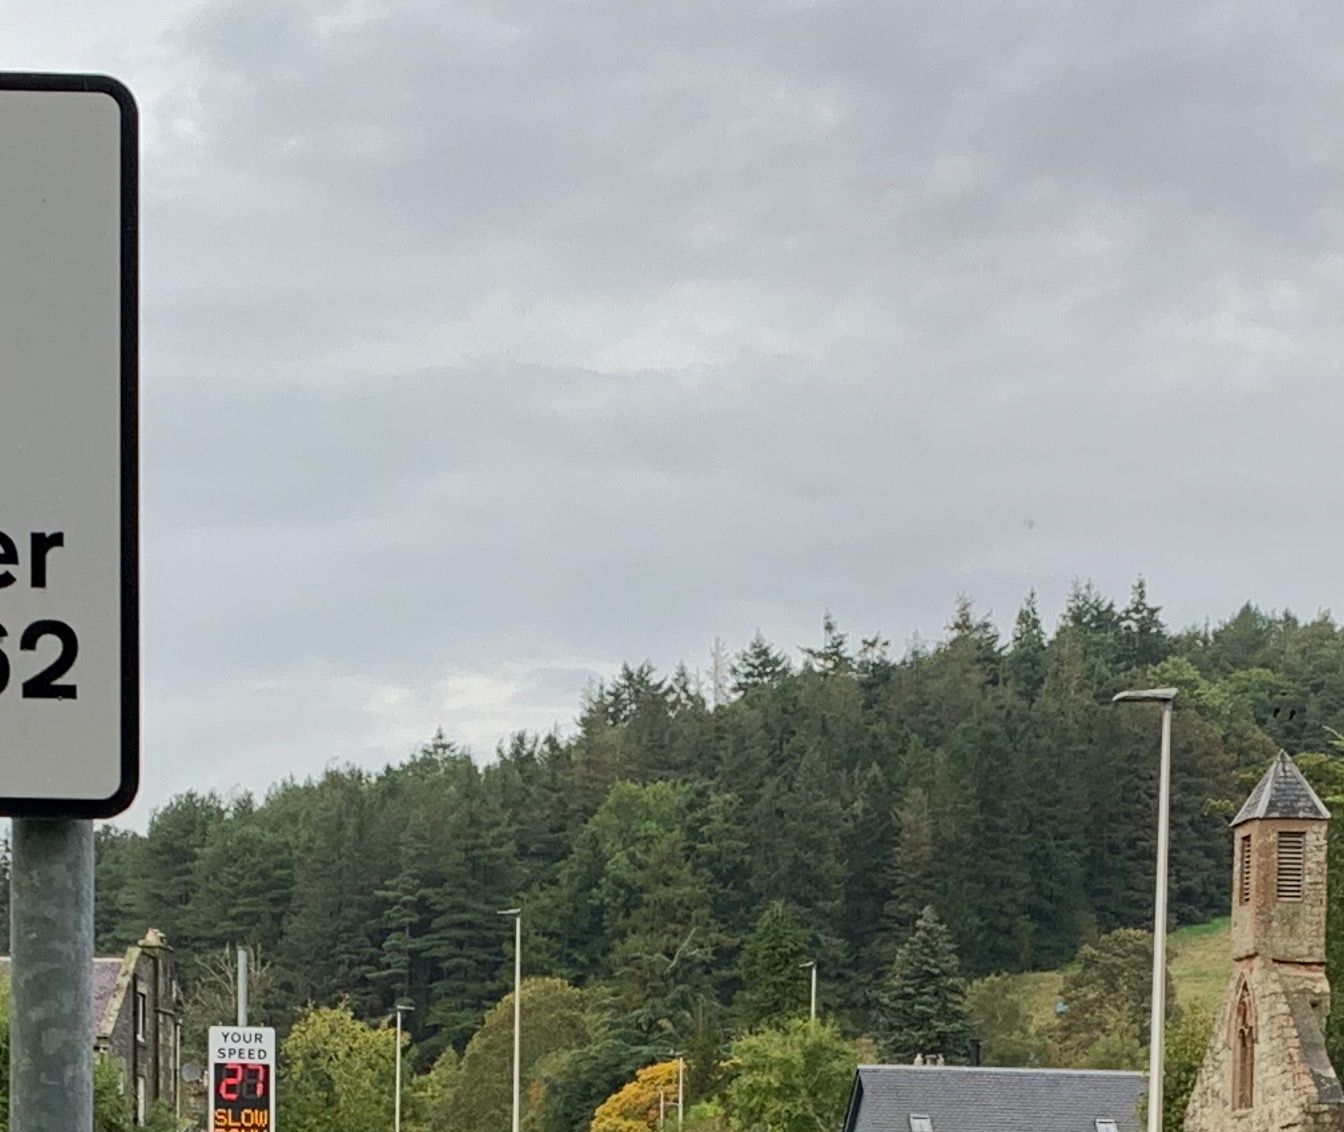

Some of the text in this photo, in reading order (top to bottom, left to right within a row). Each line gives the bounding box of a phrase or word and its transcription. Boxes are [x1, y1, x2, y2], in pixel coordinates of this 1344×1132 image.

[221, 1032, 264, 1044] YOUR
[217, 1047, 268, 1060] SPEED
[218, 1063, 266, 1101] 27
[214, 1108, 268, 1127] SLOW
